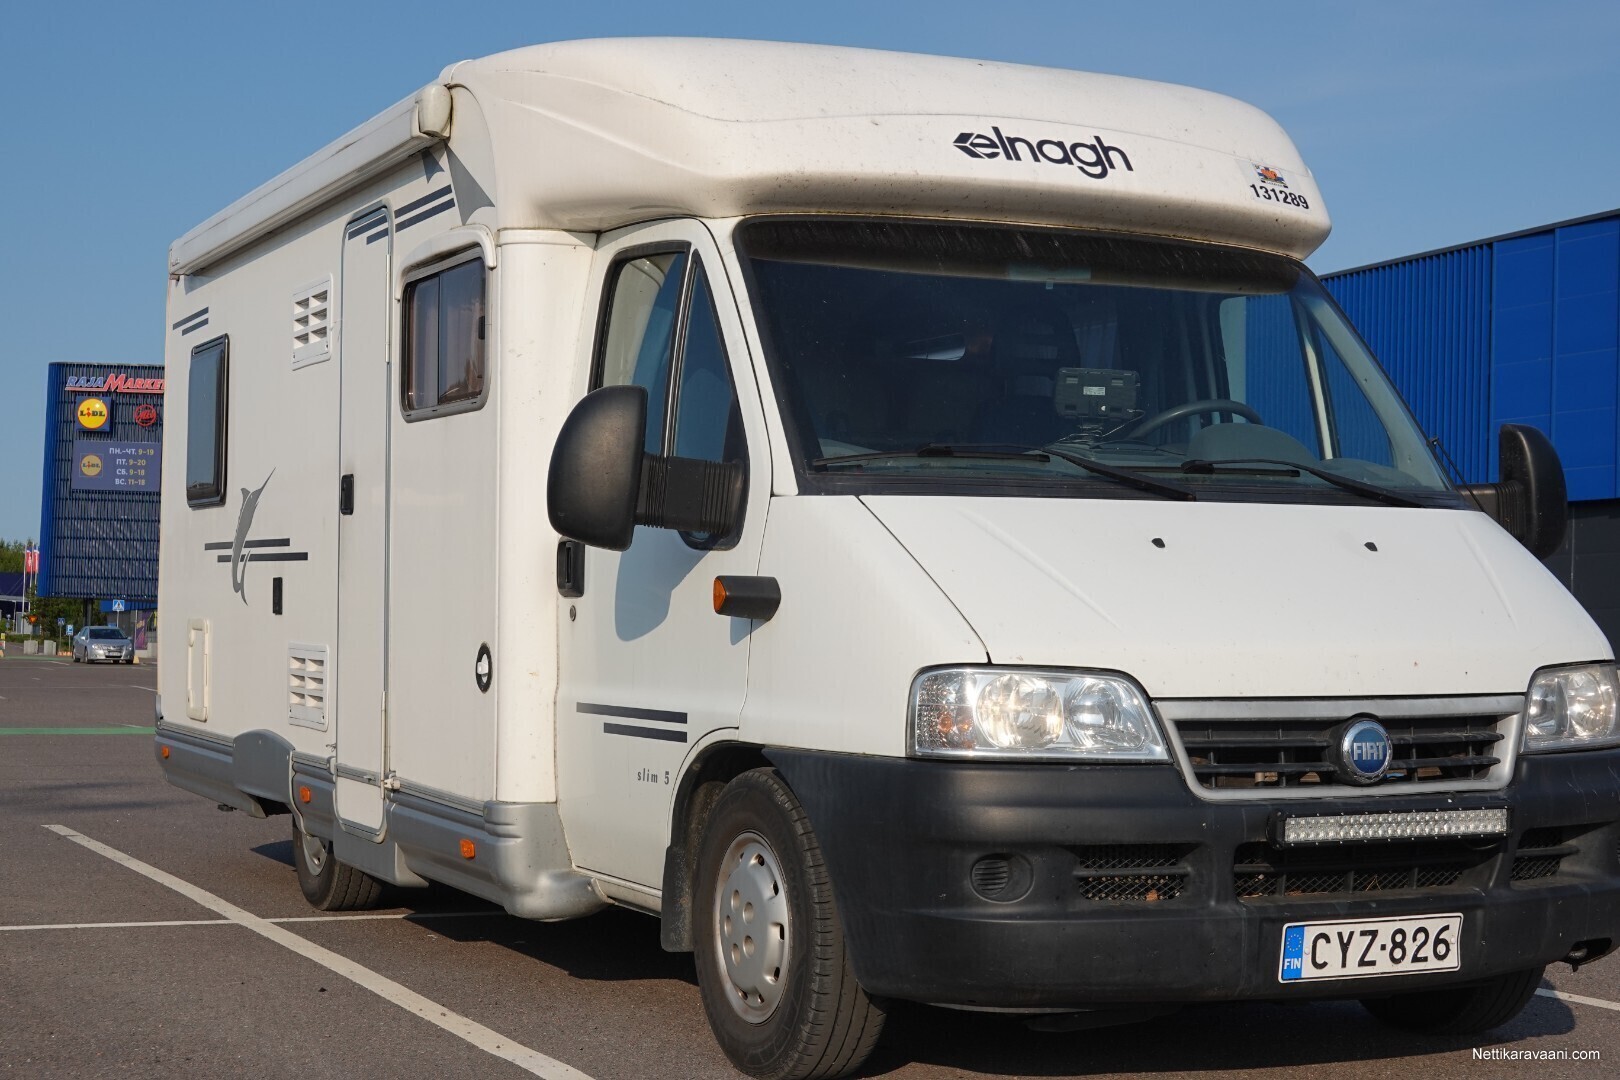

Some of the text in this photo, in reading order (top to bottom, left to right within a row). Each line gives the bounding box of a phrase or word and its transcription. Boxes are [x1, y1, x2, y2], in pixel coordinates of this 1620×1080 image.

[969, 126, 1134, 180] elnagh
[1250, 184, 1310, 210] 131289
[1353, 741, 1385, 761] FIAT
[637, 767, 670, 785] slim 5
[1311, 924, 1452, 970] CYZ-826
[1283, 957, 1301, 970] FIN
